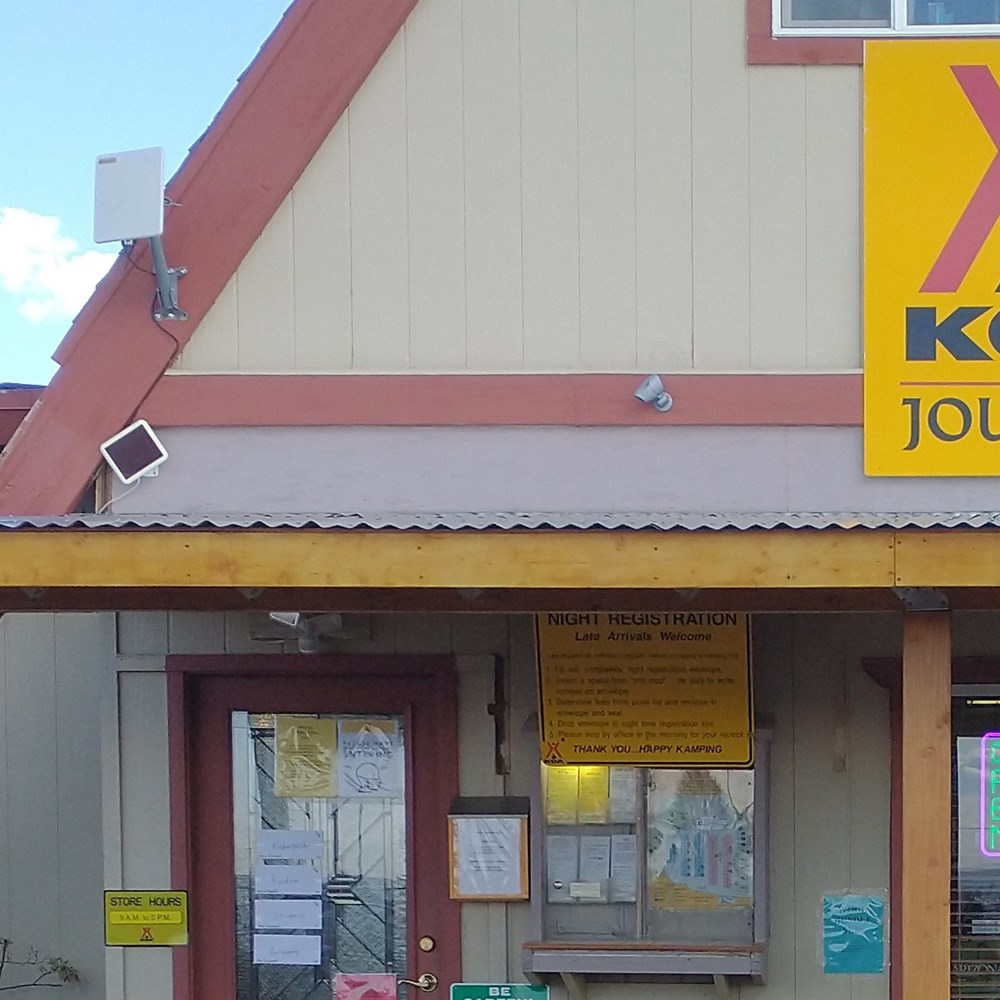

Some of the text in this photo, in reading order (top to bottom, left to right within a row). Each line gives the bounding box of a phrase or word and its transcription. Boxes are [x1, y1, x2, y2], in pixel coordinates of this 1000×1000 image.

[548, 613, 737, 626] NIGHT REGISTRATION
[575, 632, 712, 641] Late Arrivals Welcome
[573, 744, 607, 753] THANK
[676, 744, 723, 754] KAMPING
[110, 897, 182, 907] STORE HOURS
[489, 986, 511, 996] BE
